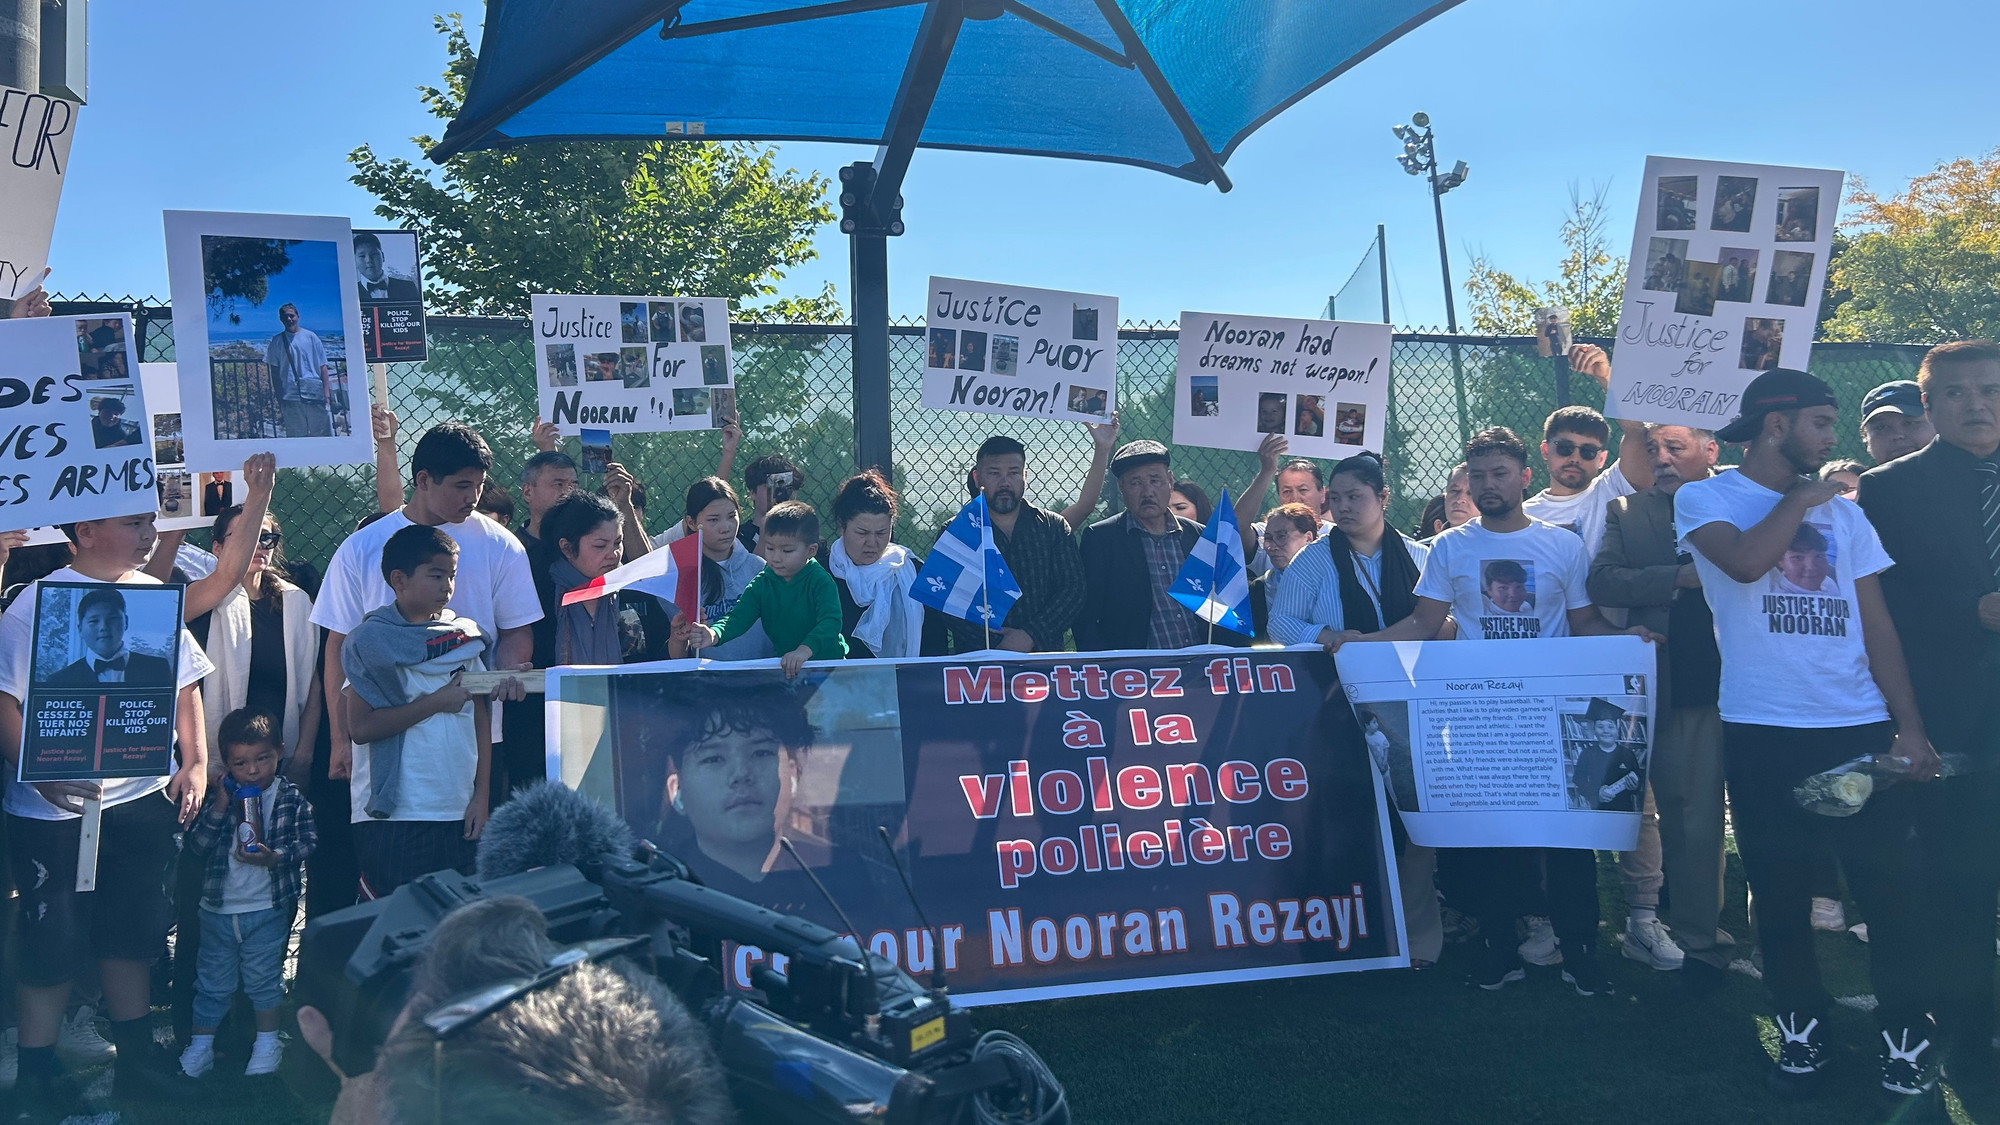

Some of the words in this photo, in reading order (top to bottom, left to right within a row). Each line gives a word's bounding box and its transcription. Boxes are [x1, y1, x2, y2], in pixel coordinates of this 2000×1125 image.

[542, 308, 612, 338] Justice
[1204, 320, 1286, 350] Nooran
[1296, 324, 1340, 356] had
[1622, 300, 1728, 352] Justice
[652, 343, 686, 378] For
[1199, 344, 1262, 373] dreams
[1270, 358, 1298, 376] not
[1306, 358, 1378, 392] weapon!
[1670, 352, 1712, 377] for
[949, 376, 1060, 414] Nooran!
[1622, 381, 1738, 415] NOORAN
[48, 458, 154, 500] ARMES
[1762, 595, 1815, 616] JUSTICE
[1819, 598, 1850, 618] POUR
[1518, 618, 1540, 632] POUR
[1768, 615, 1846, 637] NOORAN
[942, 664, 1184, 705] Mettez
[1204, 657, 1296, 696] fin
[1484, 680, 1523, 691] Rezayi
[37, 711, 78, 719] CESSEZ
[80, 711, 93, 719] DE
[45, 700, 85, 710] POLICE,
[119, 700, 157, 709] POLICE,
[106, 718, 144, 726] KILLING
[1062, 710, 1106, 749] à
[1128, 707, 1198, 746] la
[958, 756, 1309, 819] violence
[996, 817, 1292, 888] policière
[838, 923, 966, 978] our
[986, 906, 1189, 967] Nooran
[1206, 883, 1369, 950] Rezayi
